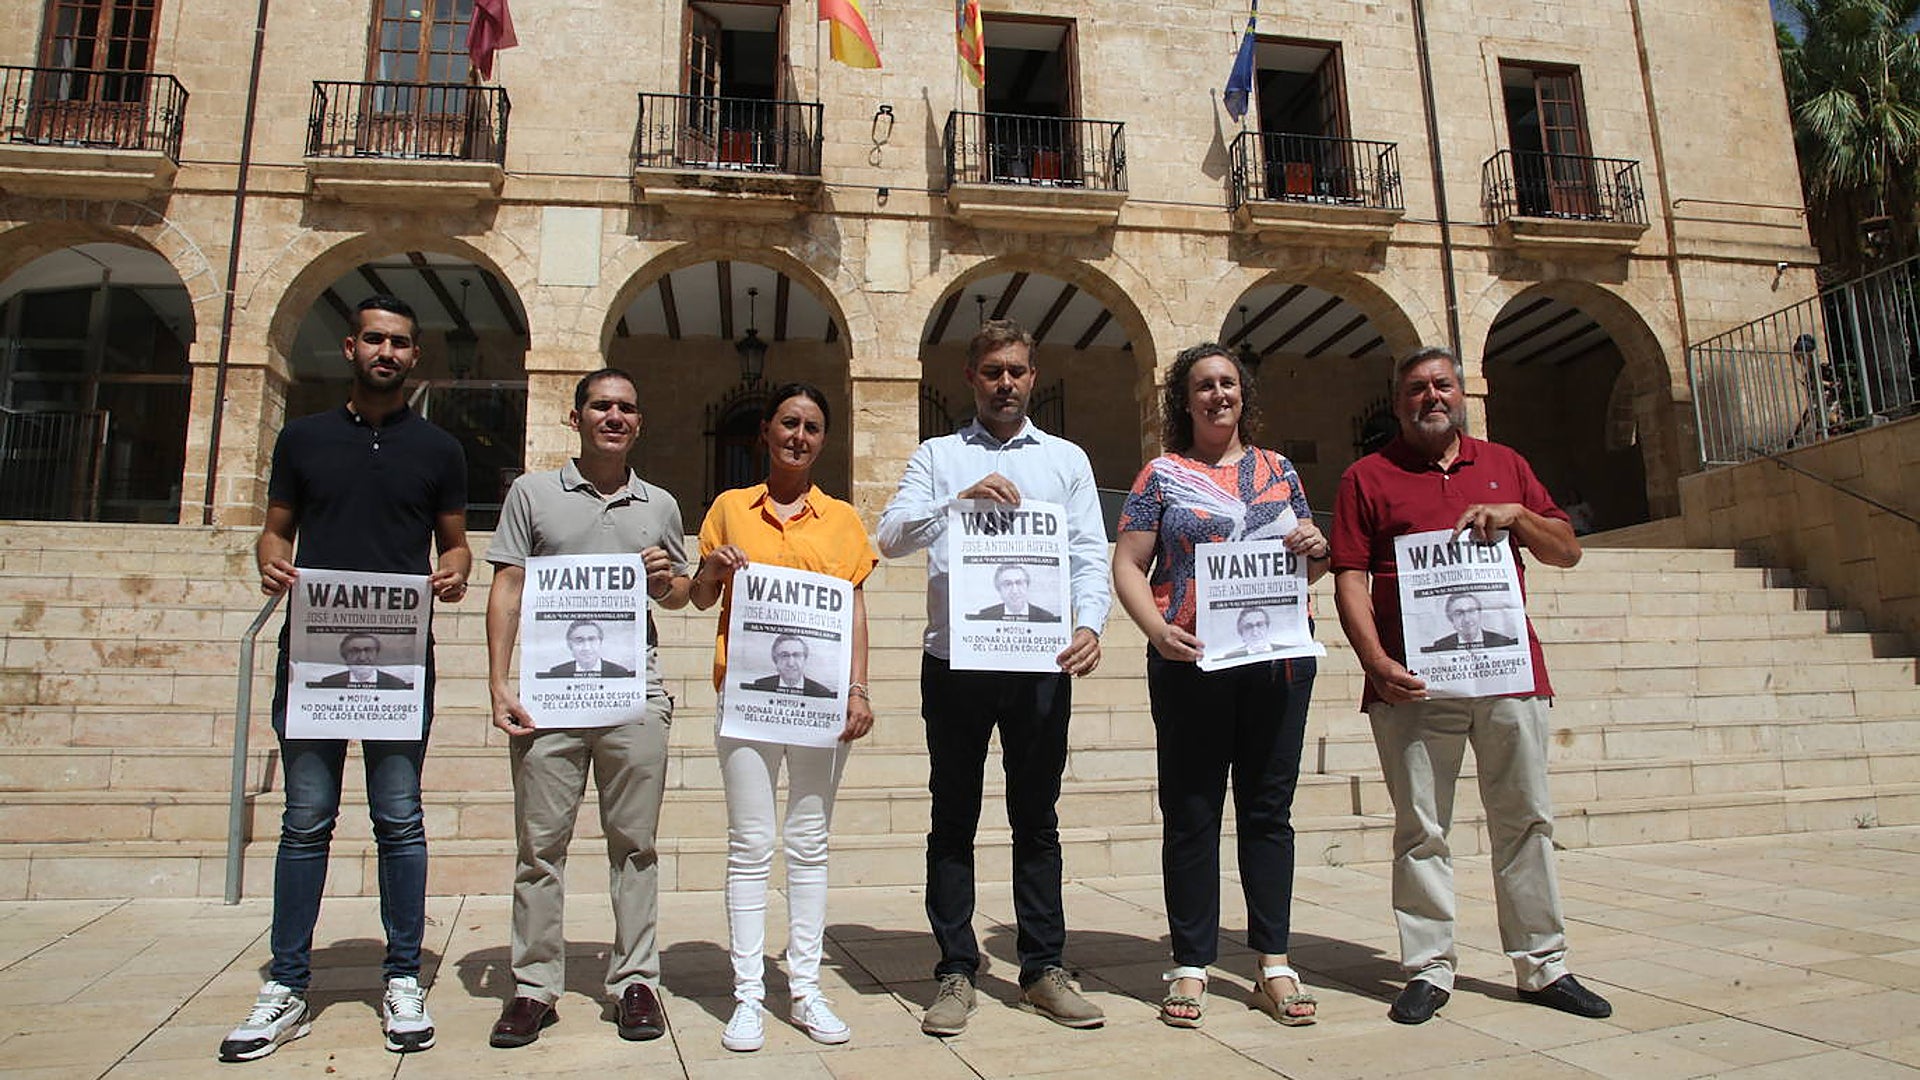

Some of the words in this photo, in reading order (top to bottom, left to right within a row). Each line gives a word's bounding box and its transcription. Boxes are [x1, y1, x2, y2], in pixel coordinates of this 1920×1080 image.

[961, 511, 1057, 536] WANTED
[1408, 541, 1502, 570] WANTED
[1207, 551, 1298, 580] WANTED
[537, 566, 636, 591] WANTED
[307, 583, 419, 610] WANTED
[746, 575, 843, 612] WANTED
[559, 595, 598, 608] ANTONIO
[601, 595, 636, 608] ROVIRA
[333, 613, 377, 624] ANTONIO
[380, 614, 418, 625] ROVIRA
[766, 607, 806, 623] ANTONIO
[808, 613, 841, 630] ROVIRA
[975, 635, 1000, 643] DONAR
[1012, 636, 1032, 644] CARA
[973, 644, 986, 652] DEL
[988, 644, 1008, 652] CAOS
[1010, 644, 1020, 652] EN
[1420, 667, 1430, 675] NO
[1432, 665, 1457, 674] DONAR
[1459, 664, 1468, 672] LA
[1470, 661, 1490, 670] CARA
[1446, 672, 1466, 681] CAOS
[1468, 671, 1478, 679] EN
[532, 693, 542, 701] NO
[545, 693, 570, 701] DONAR
[584, 692, 604, 700] CARA
[302, 704, 313, 712] NO
[315, 704, 342, 712] DONAR
[345, 704, 355, 712] LA
[357, 704, 379, 712] CARA
[542, 702, 556, 710] DEL
[559, 701, 579, 709] CAOS
[735, 704, 745, 712] NO
[747, 705, 772, 714] DONAR
[774, 708, 783, 716] LA
[785, 709, 805, 717] CARA
[312, 712, 326, 720] DEL
[329, 712, 352, 720] CAOS
[354, 712, 365, 720] EN
[745, 713, 757, 722] DEL
[760, 715, 779, 723] CAOS
[782, 717, 792, 725] EN
